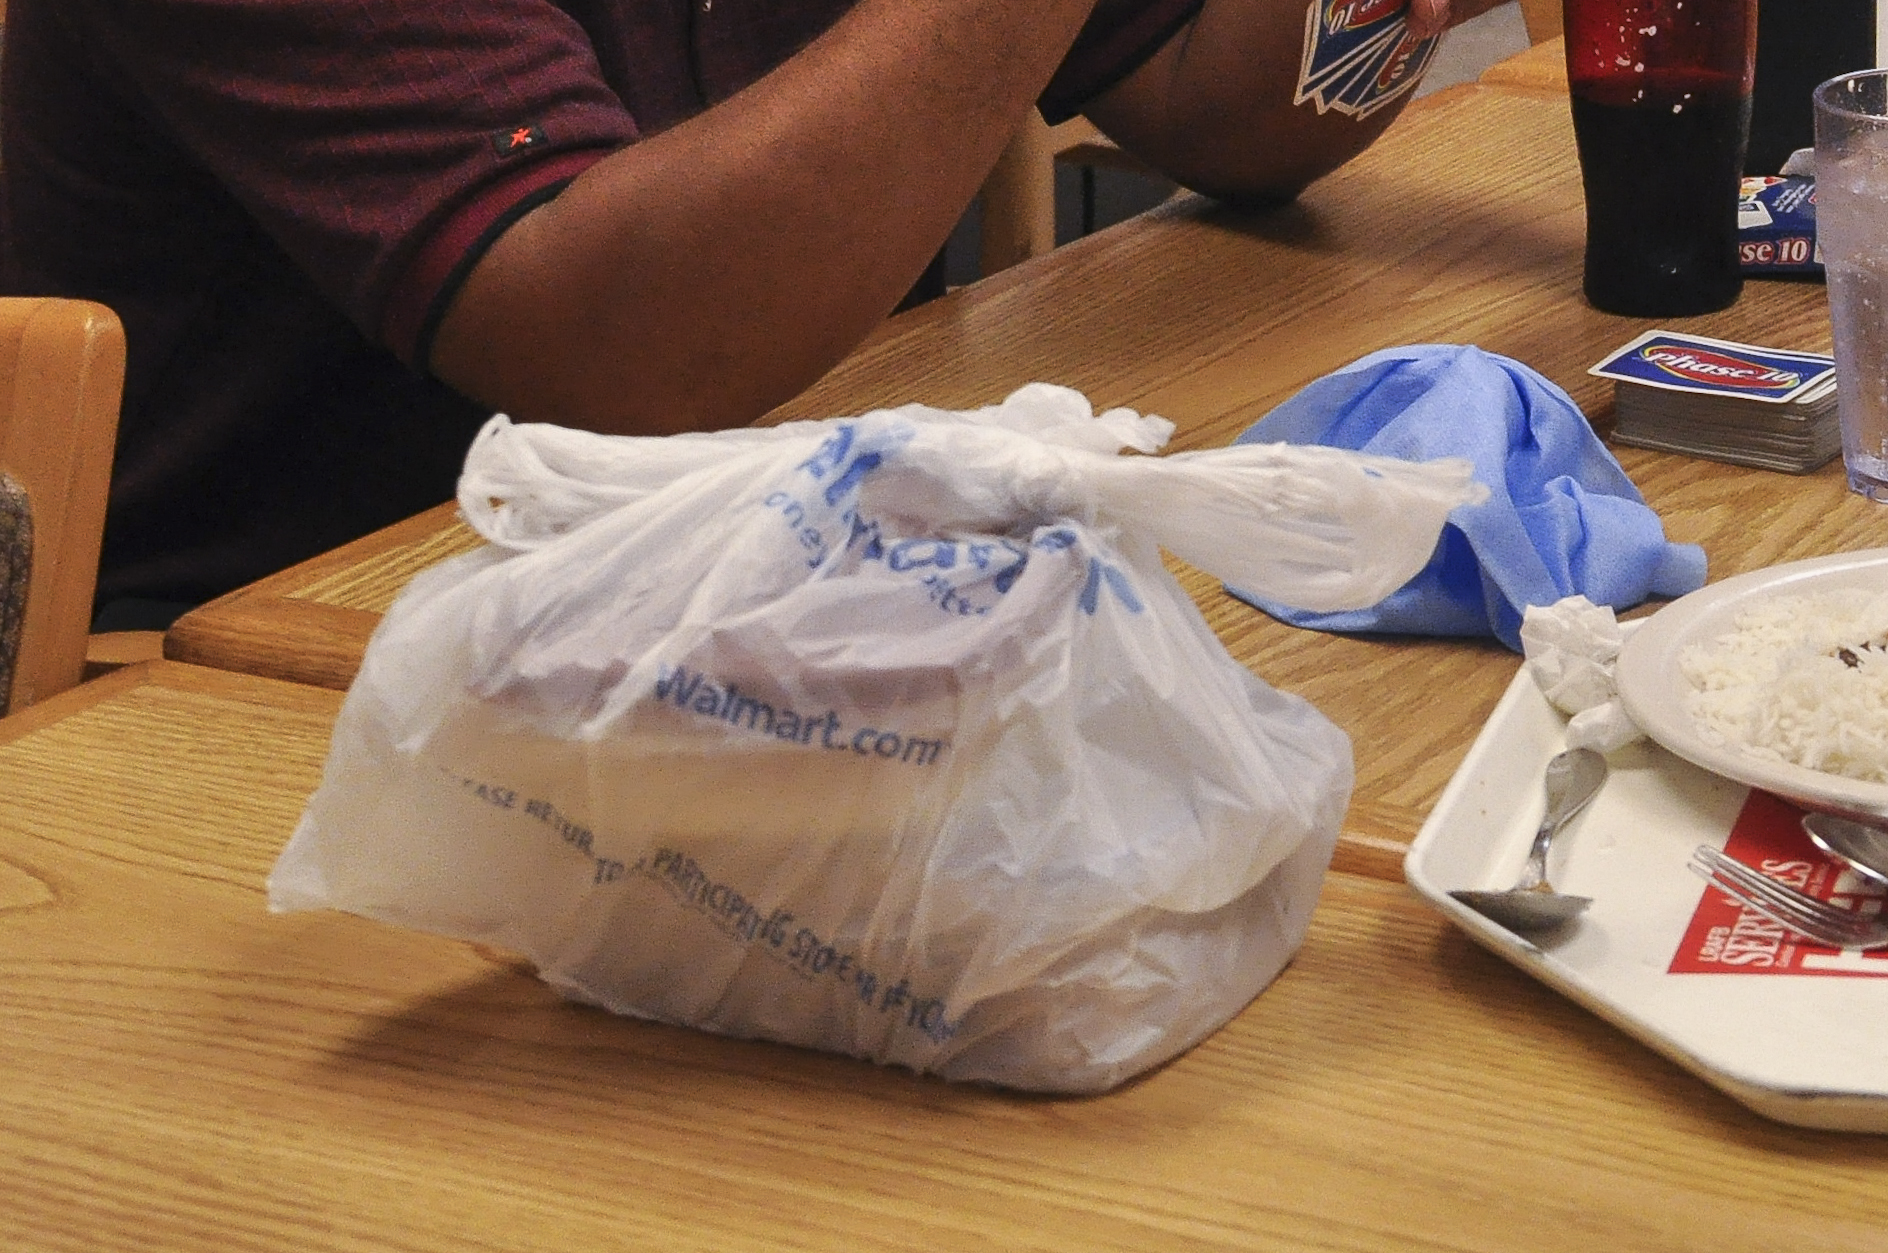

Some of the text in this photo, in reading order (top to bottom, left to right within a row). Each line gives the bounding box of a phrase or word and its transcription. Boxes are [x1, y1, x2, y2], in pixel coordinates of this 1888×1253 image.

[1780, 239, 1808, 263] 10
[1645, 352, 1799, 382] phase 10
[655, 663, 942, 765] Walmart.com
